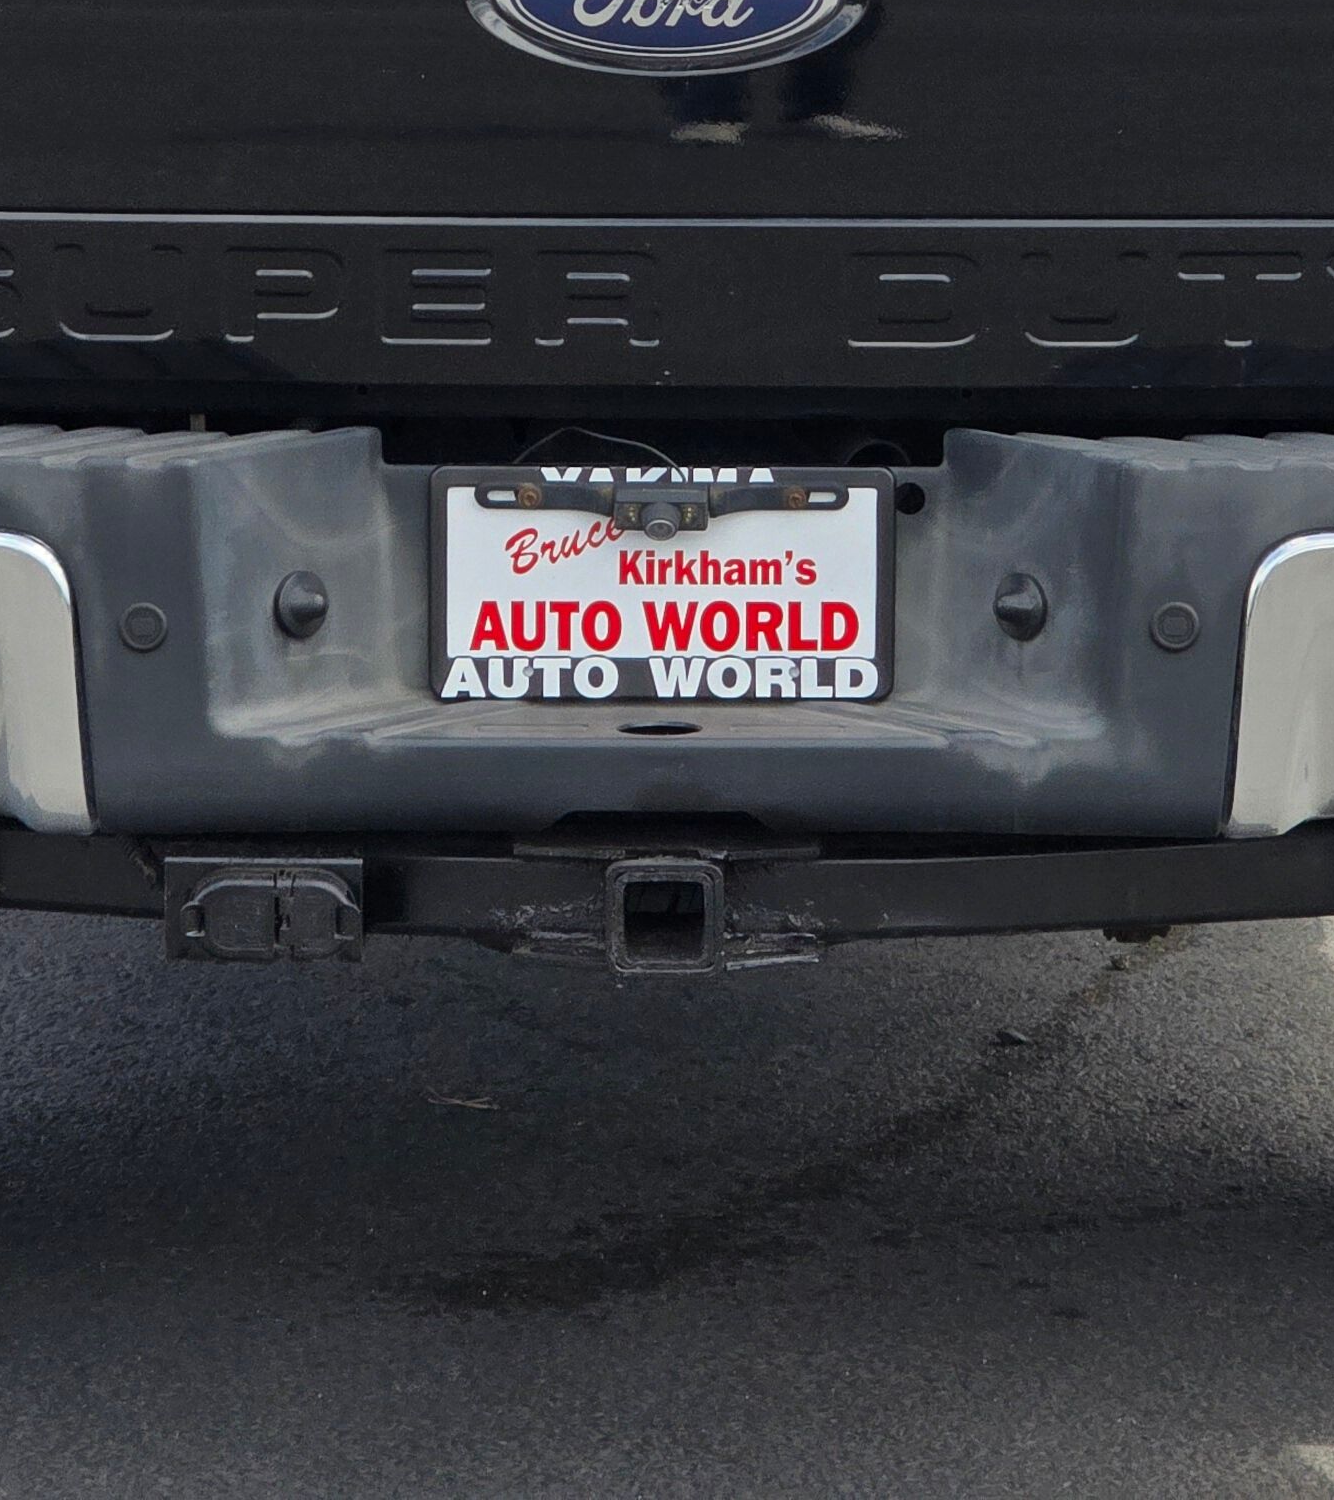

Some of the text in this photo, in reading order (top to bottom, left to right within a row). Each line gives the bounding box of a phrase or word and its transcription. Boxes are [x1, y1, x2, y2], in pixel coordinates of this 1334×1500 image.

[618, 548, 817, 586] Kirkham's
[469, 600, 859, 653] AUTO WORLD
[440, 656, 879, 698] AUTO WORLD
